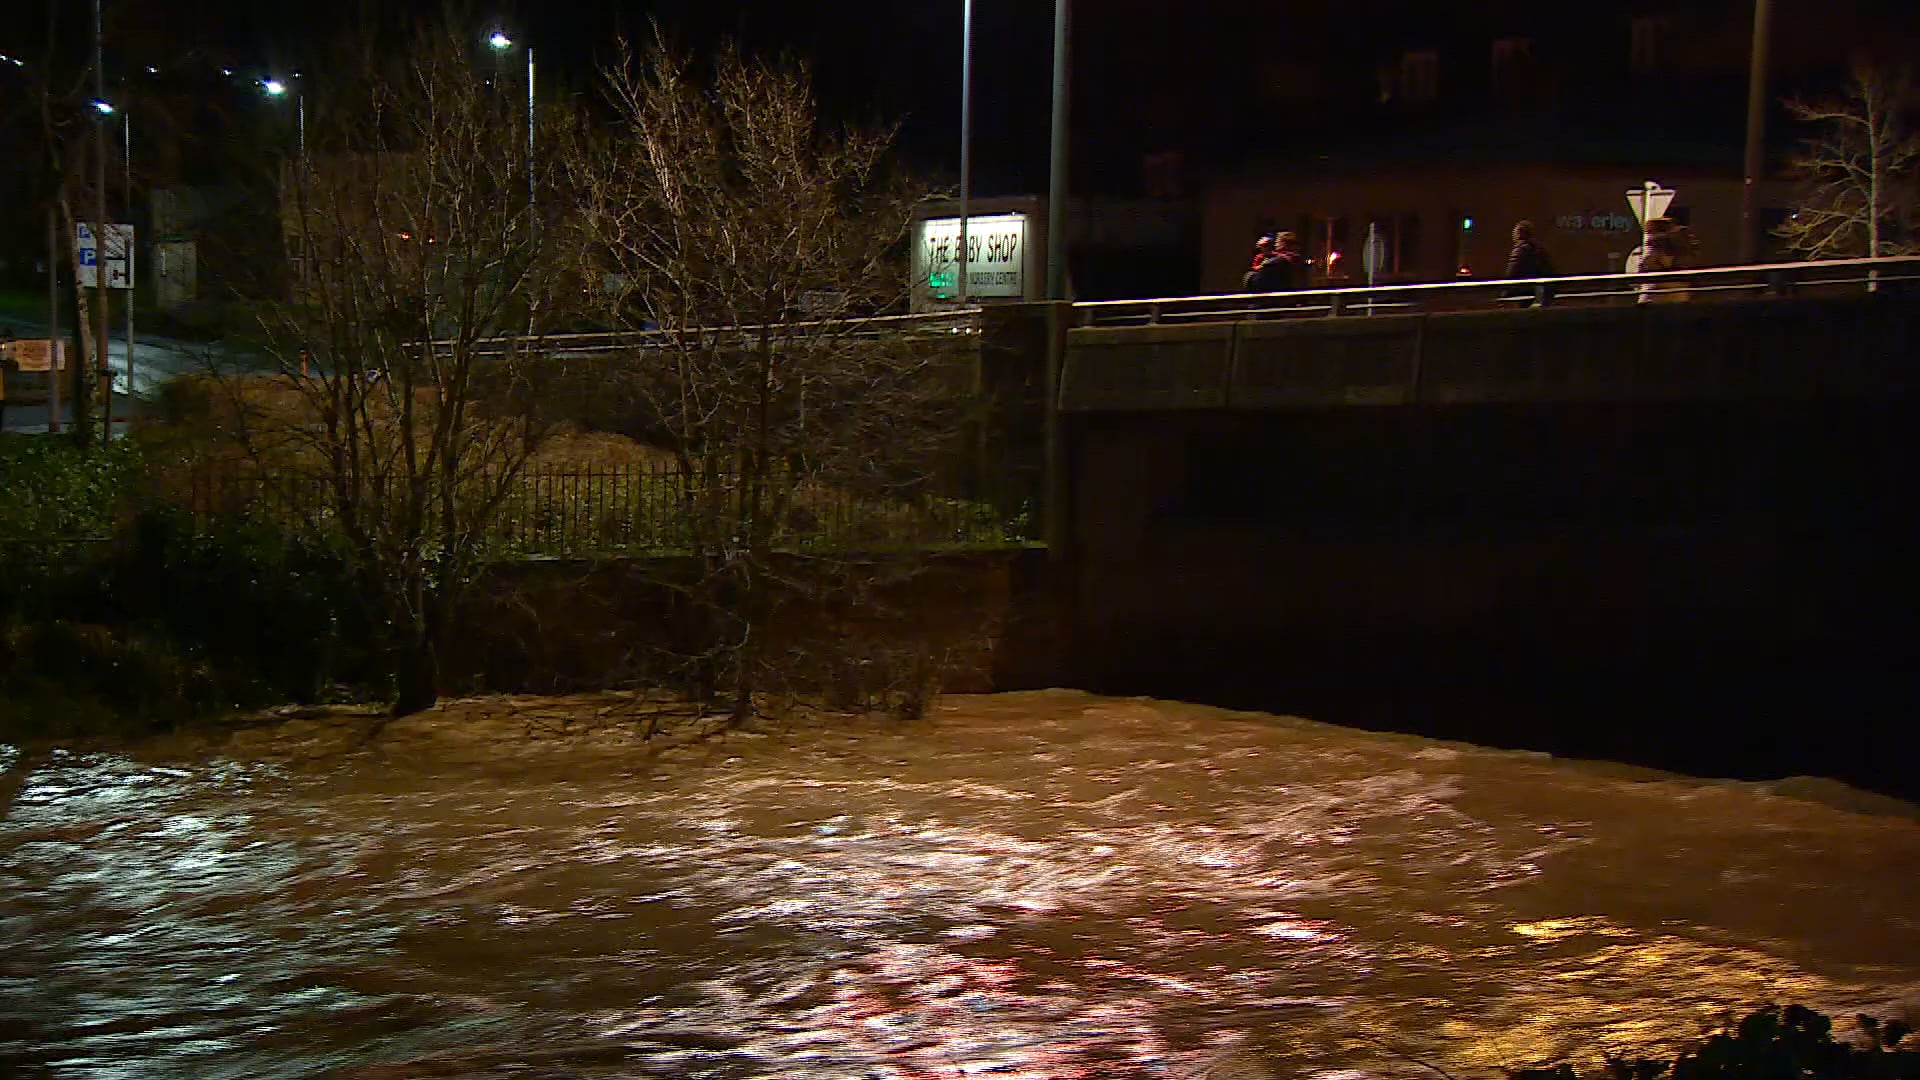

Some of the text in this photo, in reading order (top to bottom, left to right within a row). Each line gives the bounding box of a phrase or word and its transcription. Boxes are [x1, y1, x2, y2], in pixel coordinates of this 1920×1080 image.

[930, 233, 1017, 262] THE BBY SHOP
